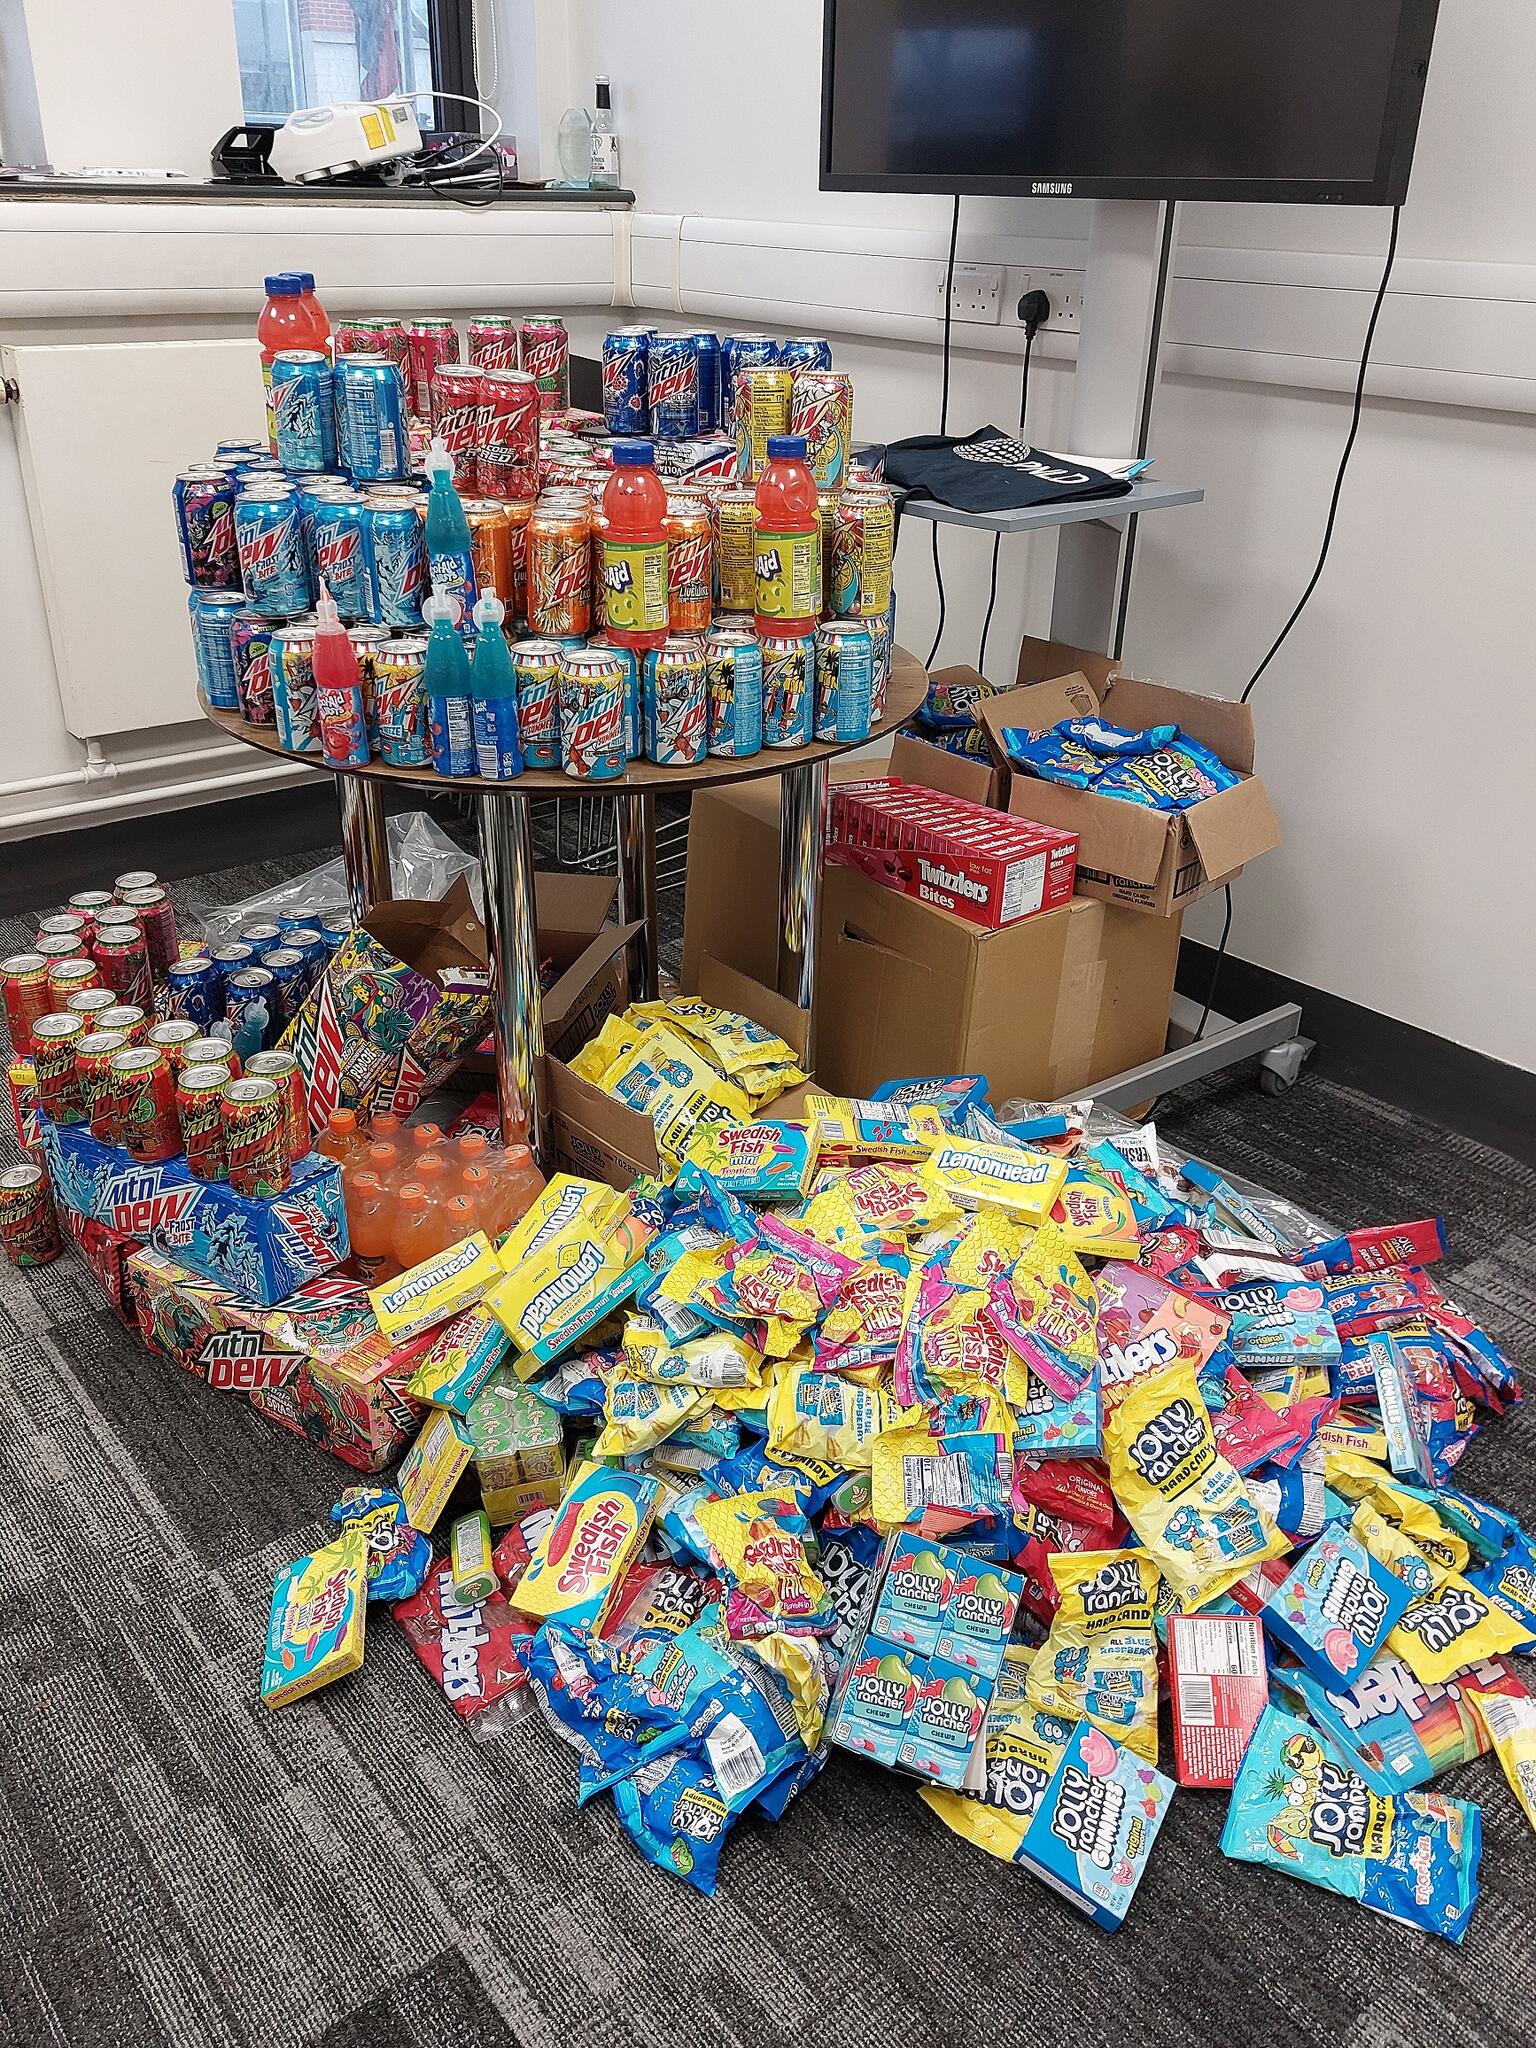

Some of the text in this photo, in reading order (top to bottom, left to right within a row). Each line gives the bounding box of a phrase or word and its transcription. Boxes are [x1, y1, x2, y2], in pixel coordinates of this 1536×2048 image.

[1031, 182, 1073, 195] SAMSUNG
[480, 450, 513, 463] RED
[255, 556, 279, 572] FROST
[257, 566, 277, 580] BITE
[332, 557, 355, 573] FROST
[335, 567, 353, 581] BITE
[526, 720, 554, 736] SUMMER
[1049, 858, 1065, 869] Bites
[1050, 843, 1077, 861] Twizzlers
[917, 857, 990, 903] Twizzlers
[969, 861, 993, 876] low fat
[919, 885, 956, 910] Bites
[350, 1048, 378, 1081] PUNCH
[894, 1078, 945, 1096] JOLLY
[718, 1125, 782, 1147] Swedish
[730, 1139, 765, 1155] Fish
[729, 1155, 759, 1166] mini
[855, 1144, 907, 1156] Swedish Fish
[720, 1166, 761, 1180] Tropical
[847, 1165, 885, 1191] TAILS
[981, 1180, 1002, 1190] Lemon
[106, 1176, 156, 1208] Mtn
[854, 1179, 899, 1212] Fish
[866, 1181, 929, 1218] Swedish
[1066, 1190, 1090, 1227] Swedish
[1082, 1198, 1100, 1221] Fish
[169, 1216, 197, 1235] FROST
[170, 1231, 193, 1246] BITE
[1240, 1208, 1277, 1244] GUMMIES
[532, 1267, 550, 1283] Lemon
[837, 1272, 906, 1311] Swedish
[1217, 1288, 1276, 1312] JOLLY
[413, 1318, 424, 1327] GET
[432, 1306, 447, 1318] TOUCH
[864, 1305, 902, 1332] TAILS
[1049, 1290, 1092, 1335] Fish
[449, 1315, 478, 1350] Fish
[461, 1318, 484, 1349] mini
[548, 1319, 579, 1351] Swedish
[577, 1308, 596, 1330] Fish
[1038, 1309, 1078, 1346] TAILS
[1248, 1334, 1284, 1347] original
[203, 1331, 259, 1359] Mtn
[960, 1323, 986, 1372] Fish
[974, 1308, 1007, 1386] Swedish
[462, 1364, 488, 1400] Swedish
[484, 1345, 502, 1368] Fish
[1237, 1354, 1295, 1365] GUMMIES
[1378, 1366, 1403, 1425] GUMMIES
[856, 1386, 865, 1445] ASPBERRY
[1130, 1400, 1191, 1473] JOLLY
[1345, 1434, 1369, 1450] Fish
[444, 1446, 470, 1490] Swedish Fish
[1159, 1466, 1191, 1495] HARD
[1206, 1471, 1225, 1488] BLUE
[1068, 1474, 1106, 1495] ORIGINAL
[551, 1517, 571, 1554] Swedish
[557, 1498, 623, 1595] Swedish
[584, 1521, 630, 1575] Fish
[623, 1504, 658, 1567] Swedish Fish
[893, 1571, 941, 1593] JOLLY
[1307, 1558, 1327, 1589] original
[322, 1568, 349, 1633] Swedish
[893, 1584, 942, 1603] rancher
[1321, 1558, 1358, 1623] GUMMIES
[1339, 1571, 1367, 1630] rancher
[296, 1601, 311, 1632] mini
[309, 1588, 331, 1628] Fish
[903, 1602, 928, 1612] CHEWS
[956, 1593, 1003, 1616] JOLLY
[956, 1608, 1005, 1627] rancher
[1352, 1577, 1389, 1647] JOLLY
[1512, 1608, 1527, 1621] ON
[282, 1601, 299, 1643] Tropical
[966, 1624, 990, 1635] CHEWS
[1085, 1614, 1118, 1631] HARD
[1109, 1638, 1124, 1646] ALL
[1248, 1622, 1259, 1676] Nutrition Facts
[267, 1677, 313, 1705] Swedish Fish
[857, 1675, 907, 1700] JOLLY
[857, 1690, 906, 1710] rancher
[865, 1707, 891, 1719] CHEWS
[921, 1697, 971, 1723] JOLLY
[922, 1713, 971, 1733] rancher
[930, 1729, 956, 1742] CHEWS
[1054, 1766, 1088, 1848] JOLLY
[1079, 1775, 1106, 1851] rancher
[1310, 1762, 1356, 1853] JOLLY
[672, 1812, 722, 1842] JOLLY
[1091, 1780, 1125, 1868] GUMMIES
[1126, 1816, 1143, 1858] original
[1369, 1808, 1393, 1855] HARD
[1416, 1835, 1431, 1905] TROPICAL
